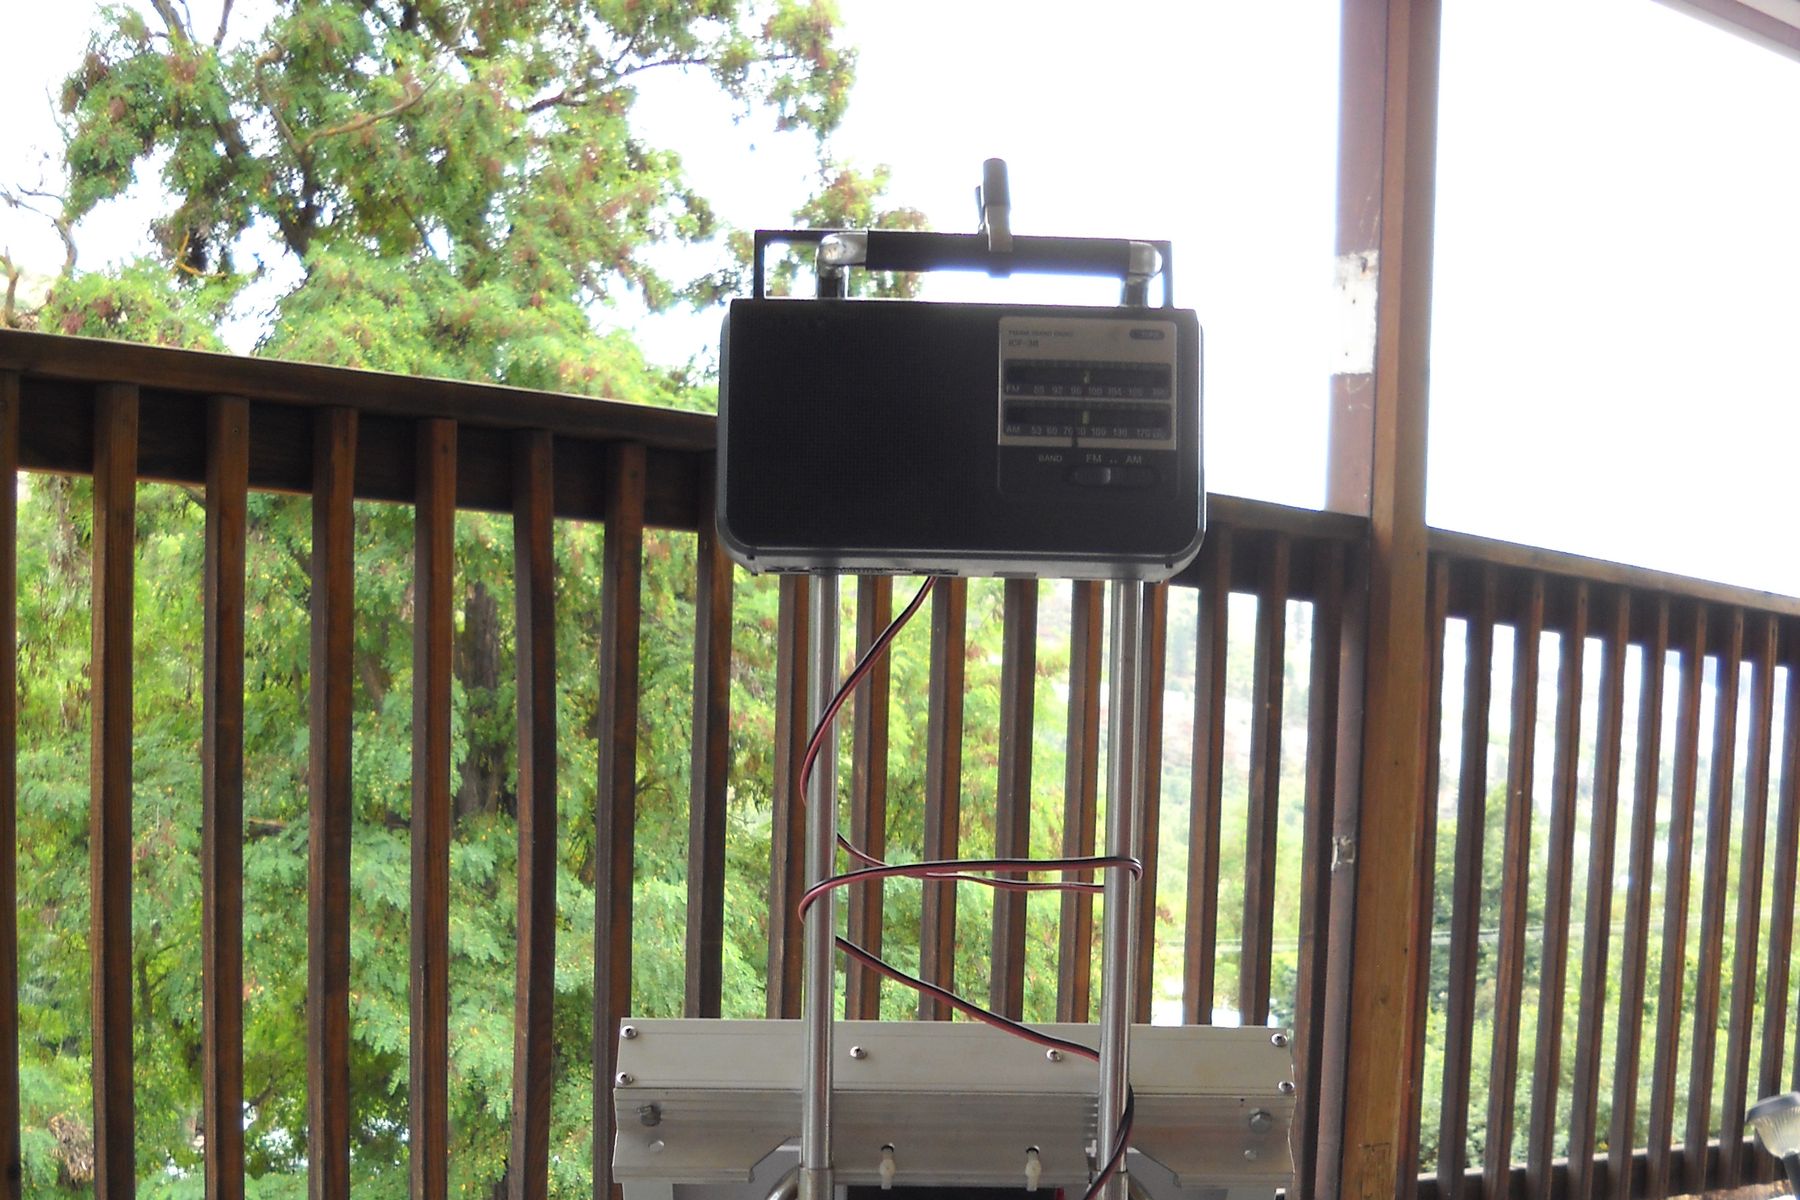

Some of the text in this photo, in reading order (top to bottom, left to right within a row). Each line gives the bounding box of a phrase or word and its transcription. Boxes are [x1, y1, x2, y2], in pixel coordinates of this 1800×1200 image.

[1006, 385, 1020, 393] FM
[1006, 426, 1020, 434] AM
[1039, 454, 1142, 465] BAND FM AM
